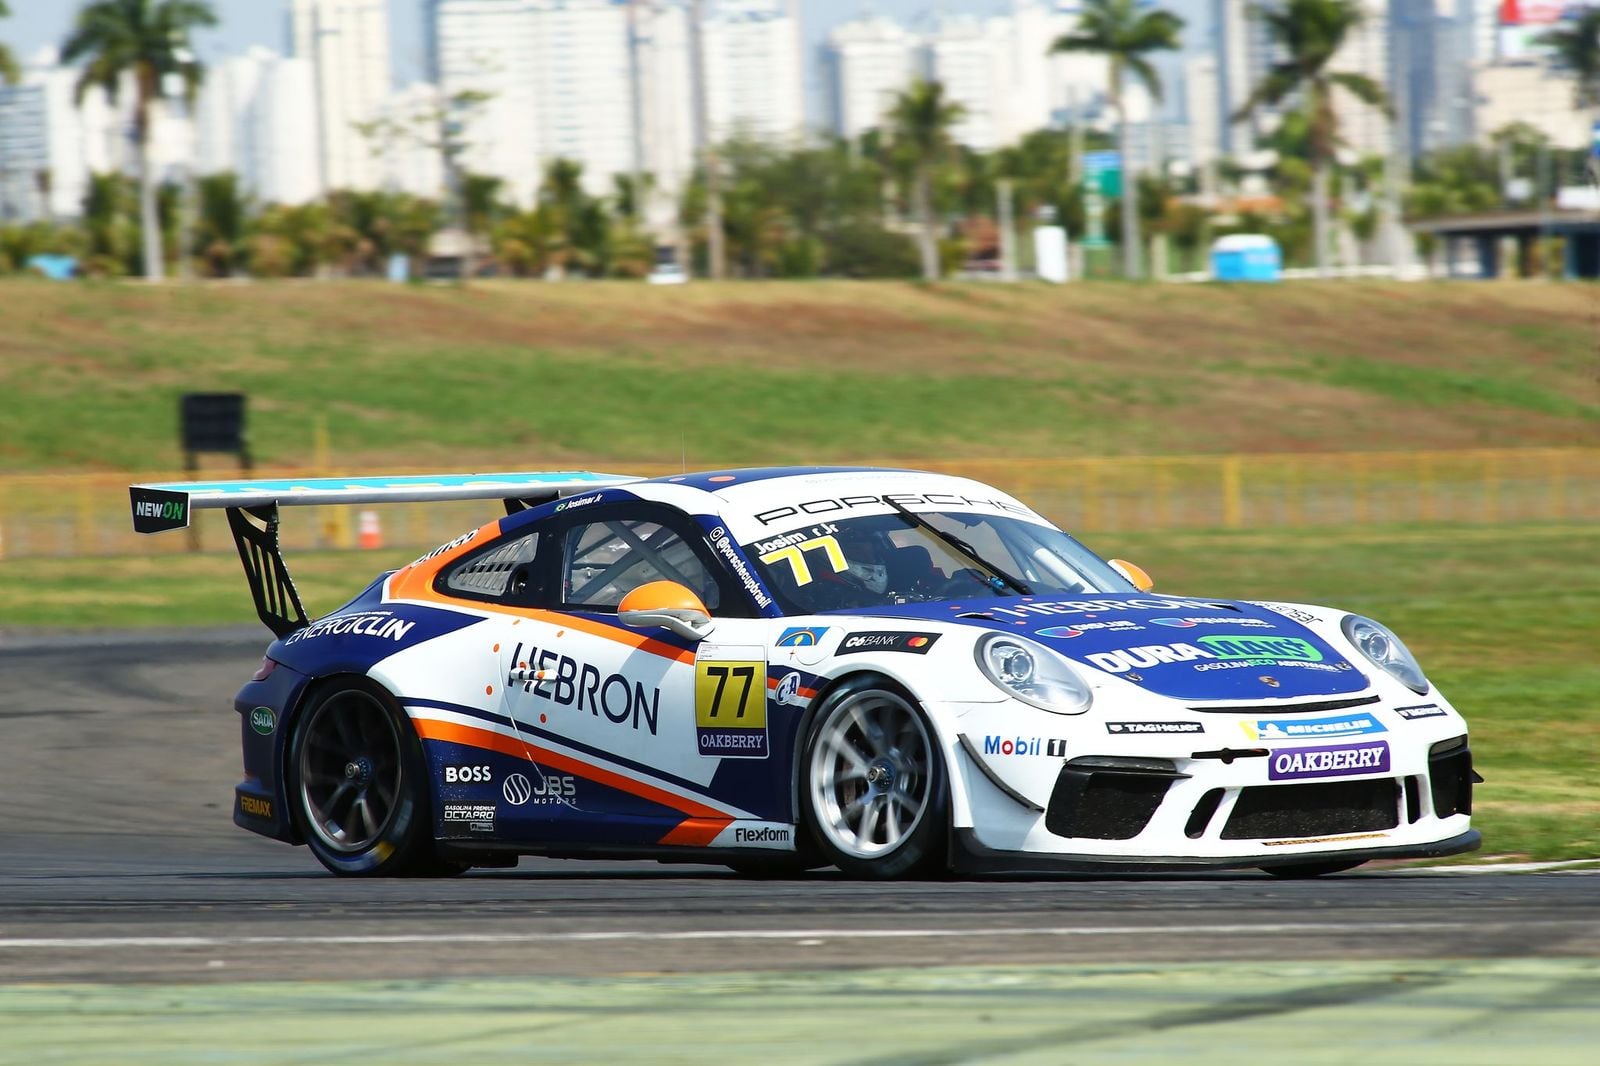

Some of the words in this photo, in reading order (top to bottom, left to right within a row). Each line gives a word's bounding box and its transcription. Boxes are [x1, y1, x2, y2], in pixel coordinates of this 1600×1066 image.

[753, 494, 1033, 526] PORSCHE
[758, 534, 850, 587] 77
[716, 536, 772, 609] @porschecupbrasil
[990, 599, 1226, 617] HEBRON
[285, 614, 416, 646] ENERGICLIN
[508, 642, 660, 736] HEBRON
[707, 666, 755, 718] 77
[253, 713, 273, 729] SADA
[1286, 719, 1372, 734] MICHELIN
[700, 734, 764, 749] OAKBERRY
[984, 735, 1041, 756] Mobil
[1275, 746, 1385, 774] OAKBERRY
[445, 765, 492, 783] BOSS
[533, 776, 576, 796] JBS
[240, 796, 272, 818] FREMAX
[444, 810, 495, 821] OCTAPRO
[735, 827, 789, 842] Flexform
